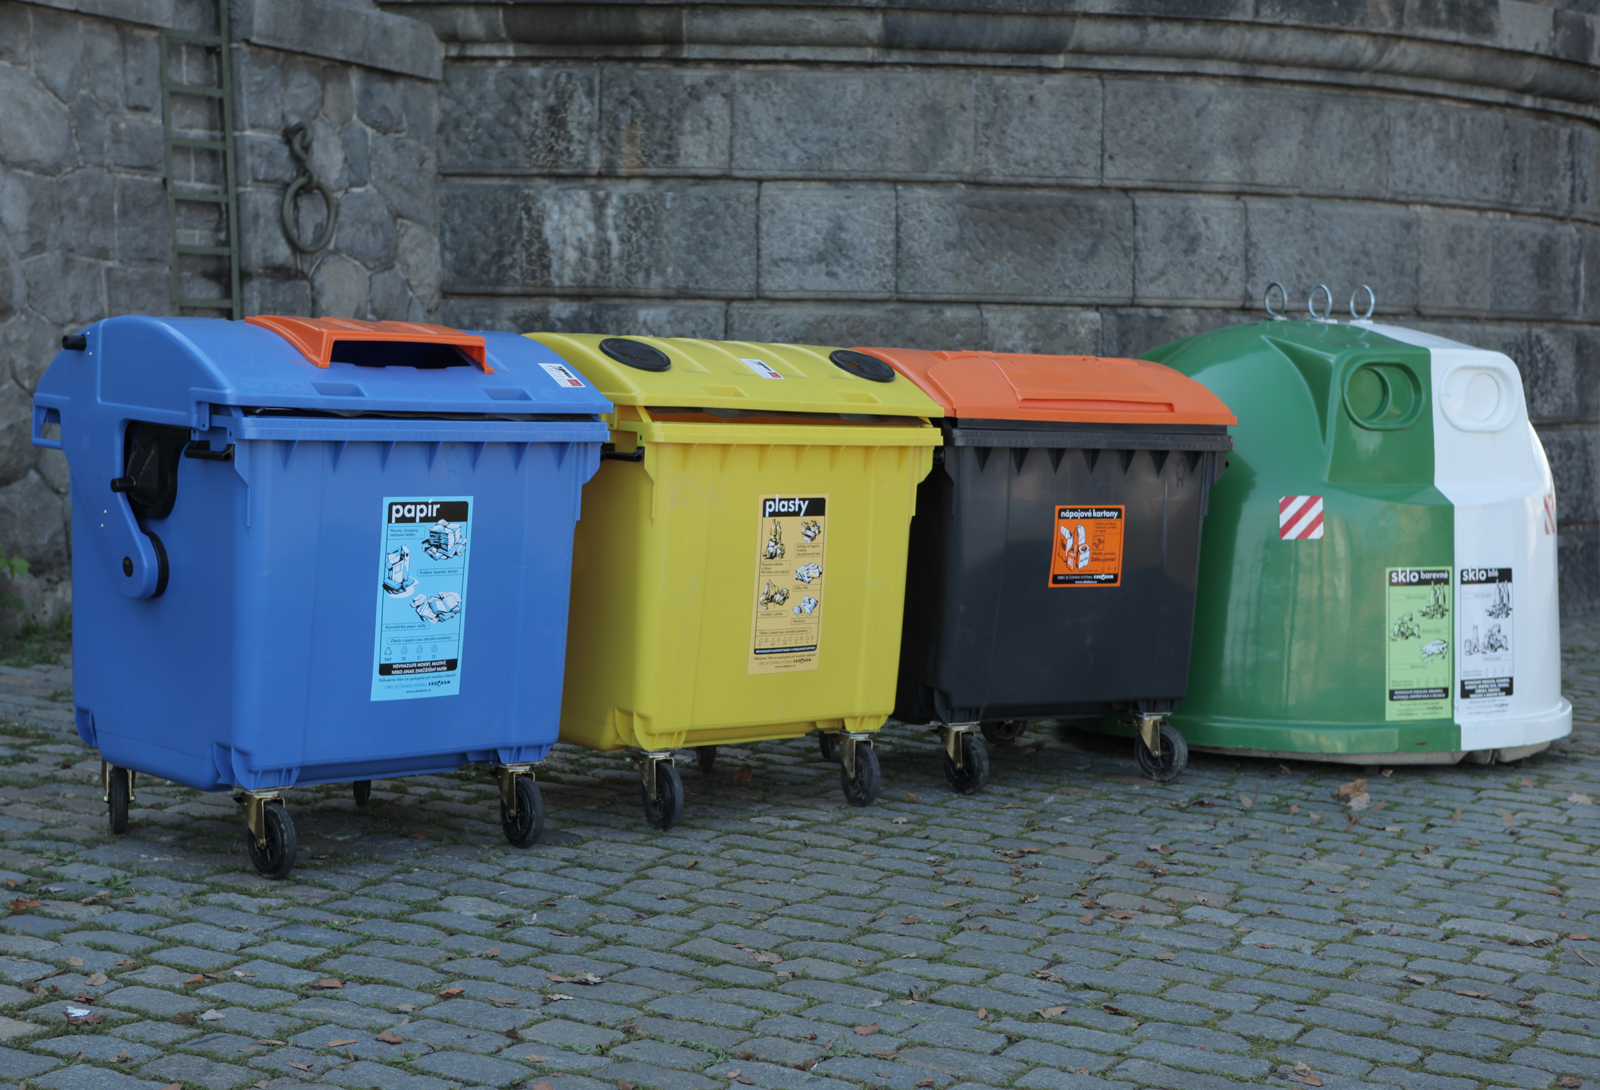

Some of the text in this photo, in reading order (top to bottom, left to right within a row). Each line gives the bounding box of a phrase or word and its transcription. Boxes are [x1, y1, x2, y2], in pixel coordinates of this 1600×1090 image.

[391, 498, 440, 523] papír
[765, 494, 809, 517] plasty
[1060, 508, 1118, 519] nápojové kartony
[1391, 567, 1448, 582] sklo barevné
[1462, 566, 1499, 581] sklo bílé
